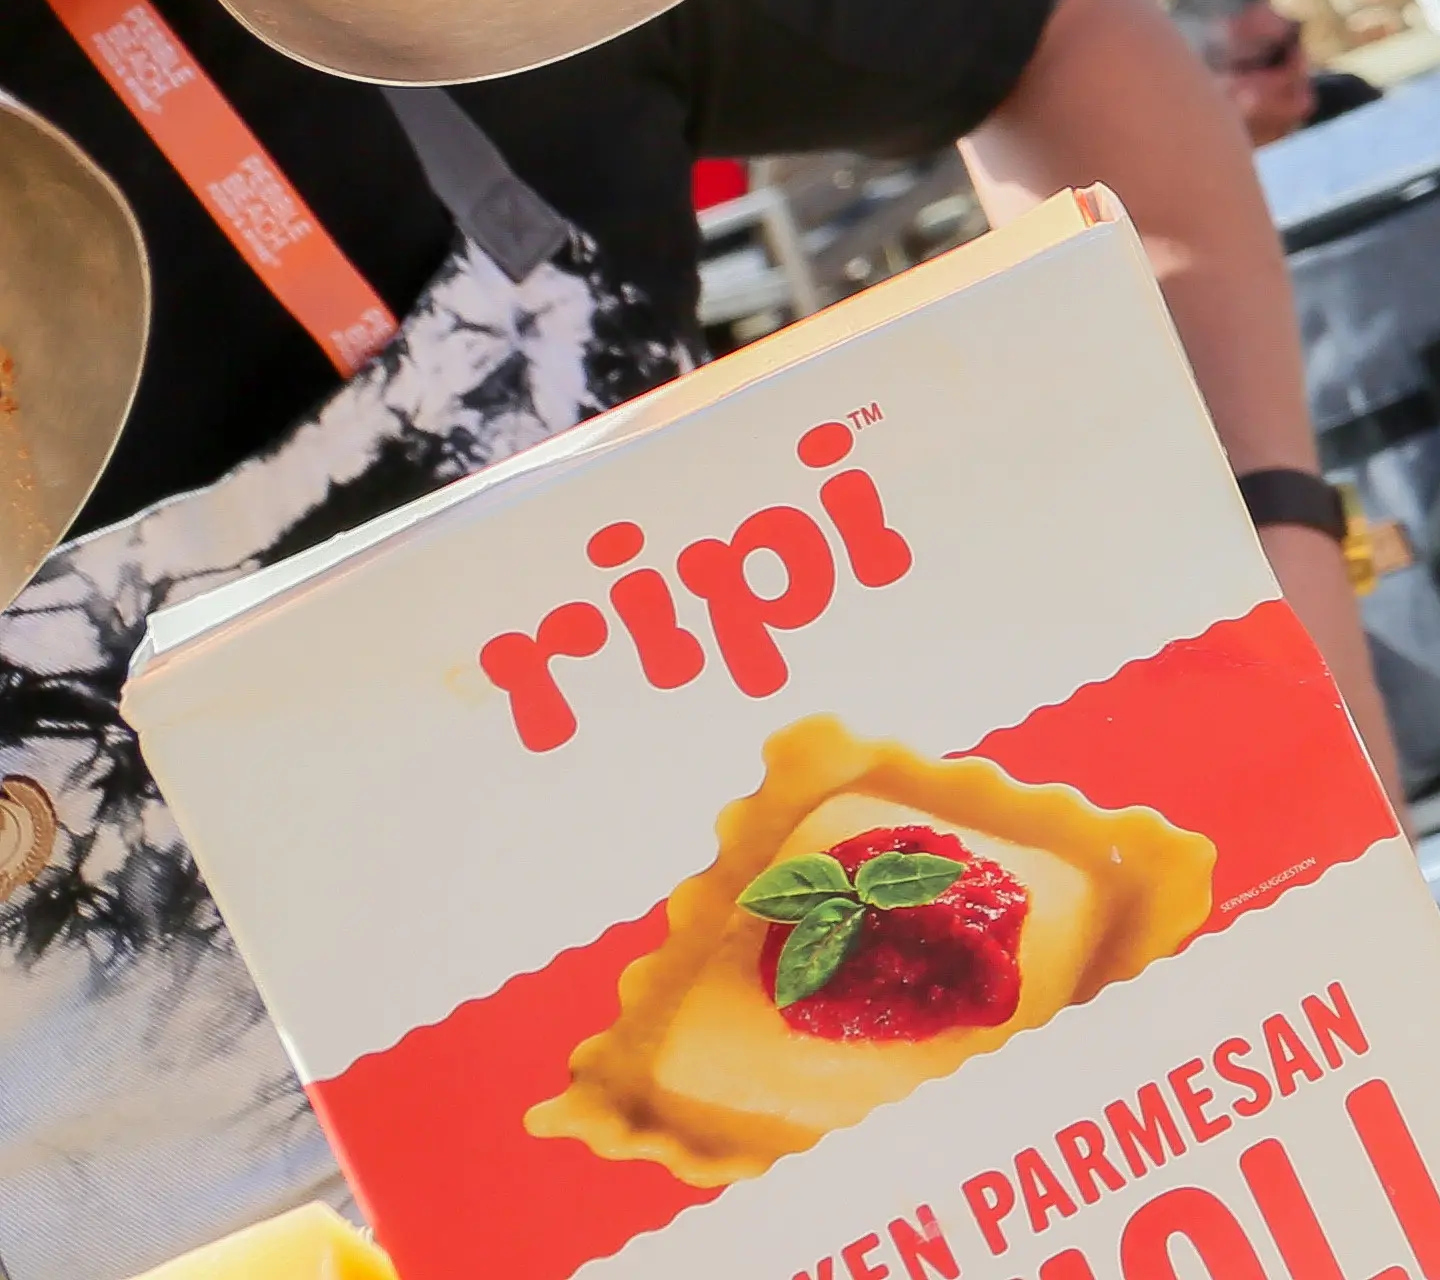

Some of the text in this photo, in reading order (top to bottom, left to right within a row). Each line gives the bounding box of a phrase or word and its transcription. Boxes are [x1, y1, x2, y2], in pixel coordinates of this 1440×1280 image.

[481, 422, 913, 753] ripi
[1220, 856, 1317, 913] SERVING SUGGESTION
[962, 981, 1370, 1255] PARMESAN
